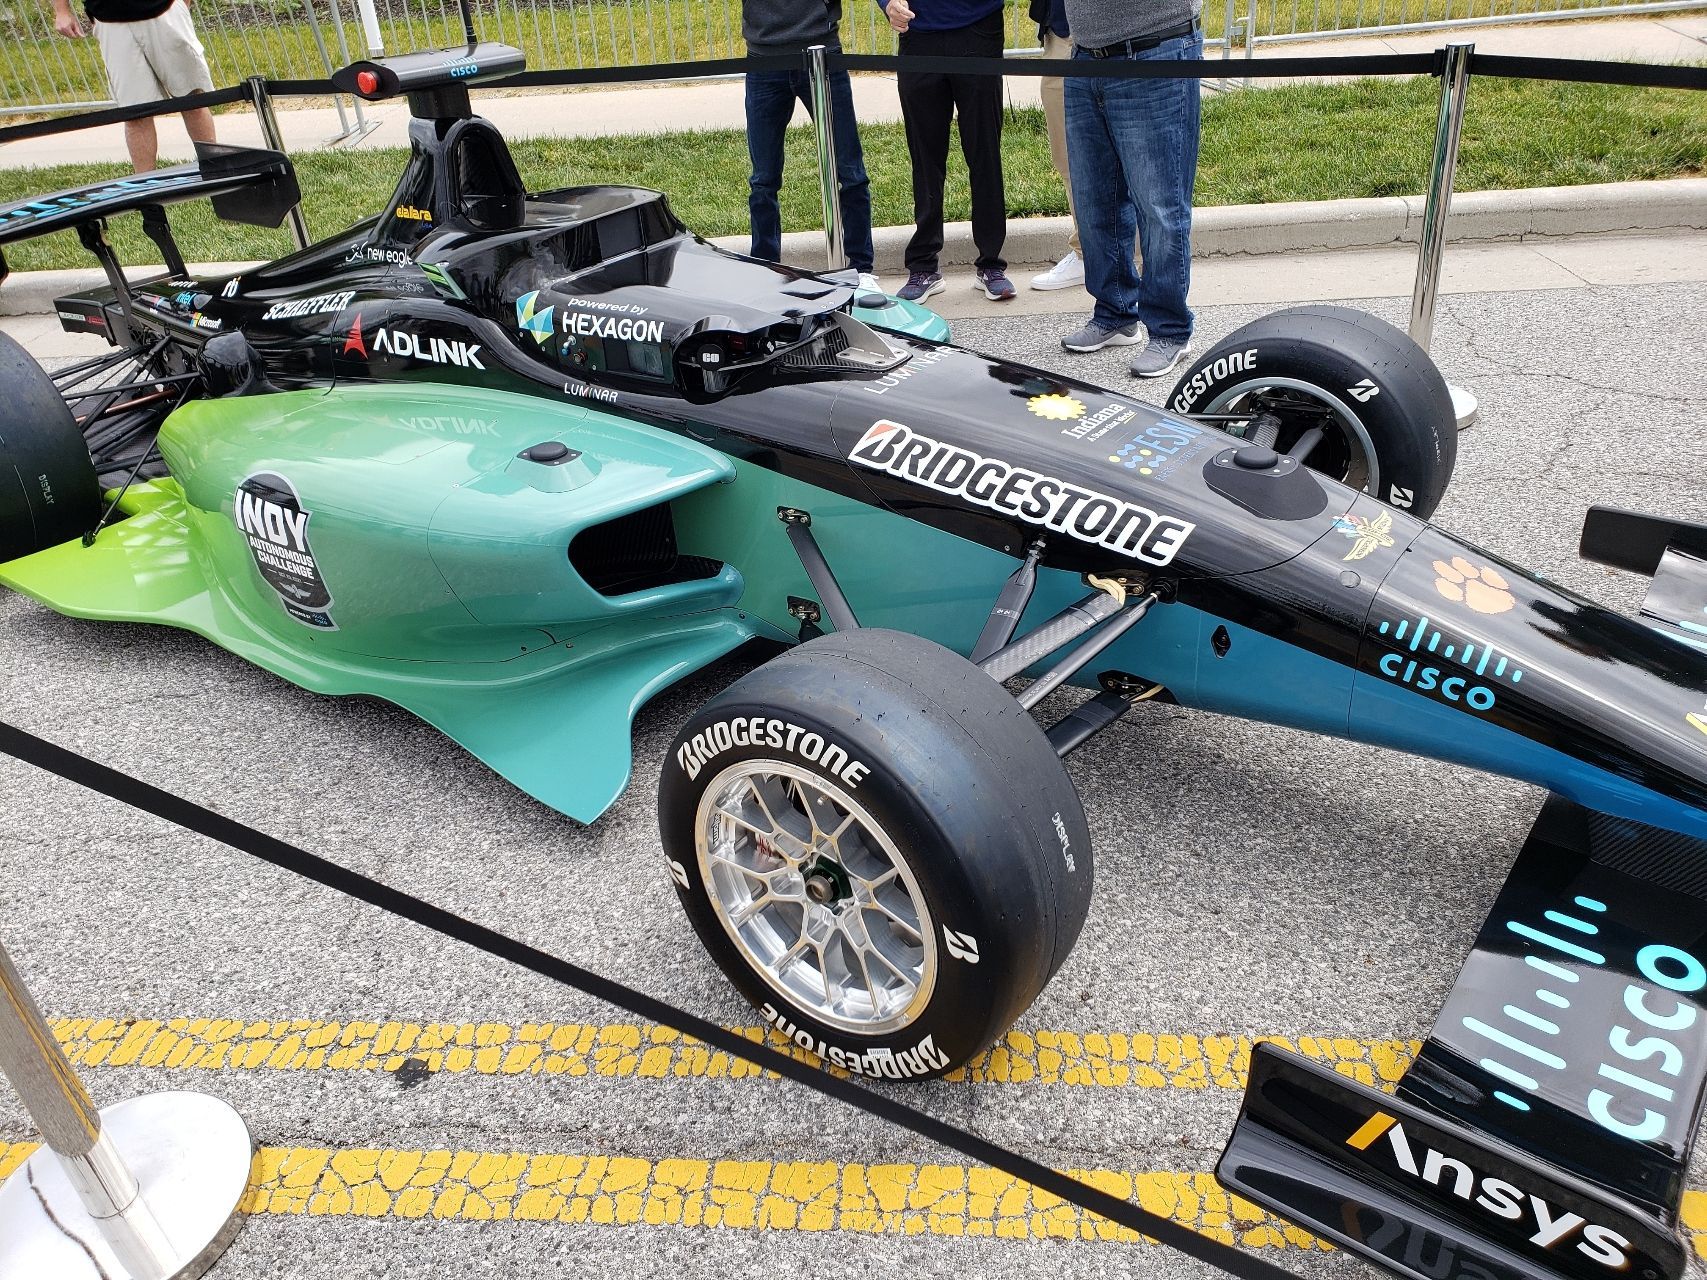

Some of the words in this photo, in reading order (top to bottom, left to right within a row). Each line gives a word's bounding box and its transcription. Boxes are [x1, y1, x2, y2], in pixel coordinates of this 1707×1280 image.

[367, 247, 385, 261] new
[262, 290, 356, 320] SCHAEFFLER
[567, 297, 628, 314] powered
[630, 305, 649, 317] by
[562, 312, 664, 343] HEXAGON
[373, 328, 486, 370] ADLINK
[864, 345, 953, 394] LUMINAR
[1171, 349, 1258, 415] GESTONE
[563, 382, 619, 403] LUMINAR
[1061, 403, 1127, 440] Indiana
[847, 419, 1196, 567] BRIDGESTONE
[235, 488, 308, 552] INDY
[250, 535, 315, 568] AUTONOMOUS
[257, 550, 315, 580] CHALLENGE
[677, 717, 872, 790] BRIDGESTONE
[759, 1002, 950, 1080] BRIDGESTONE
[1345, 1111, 1631, 1269] Ansys
